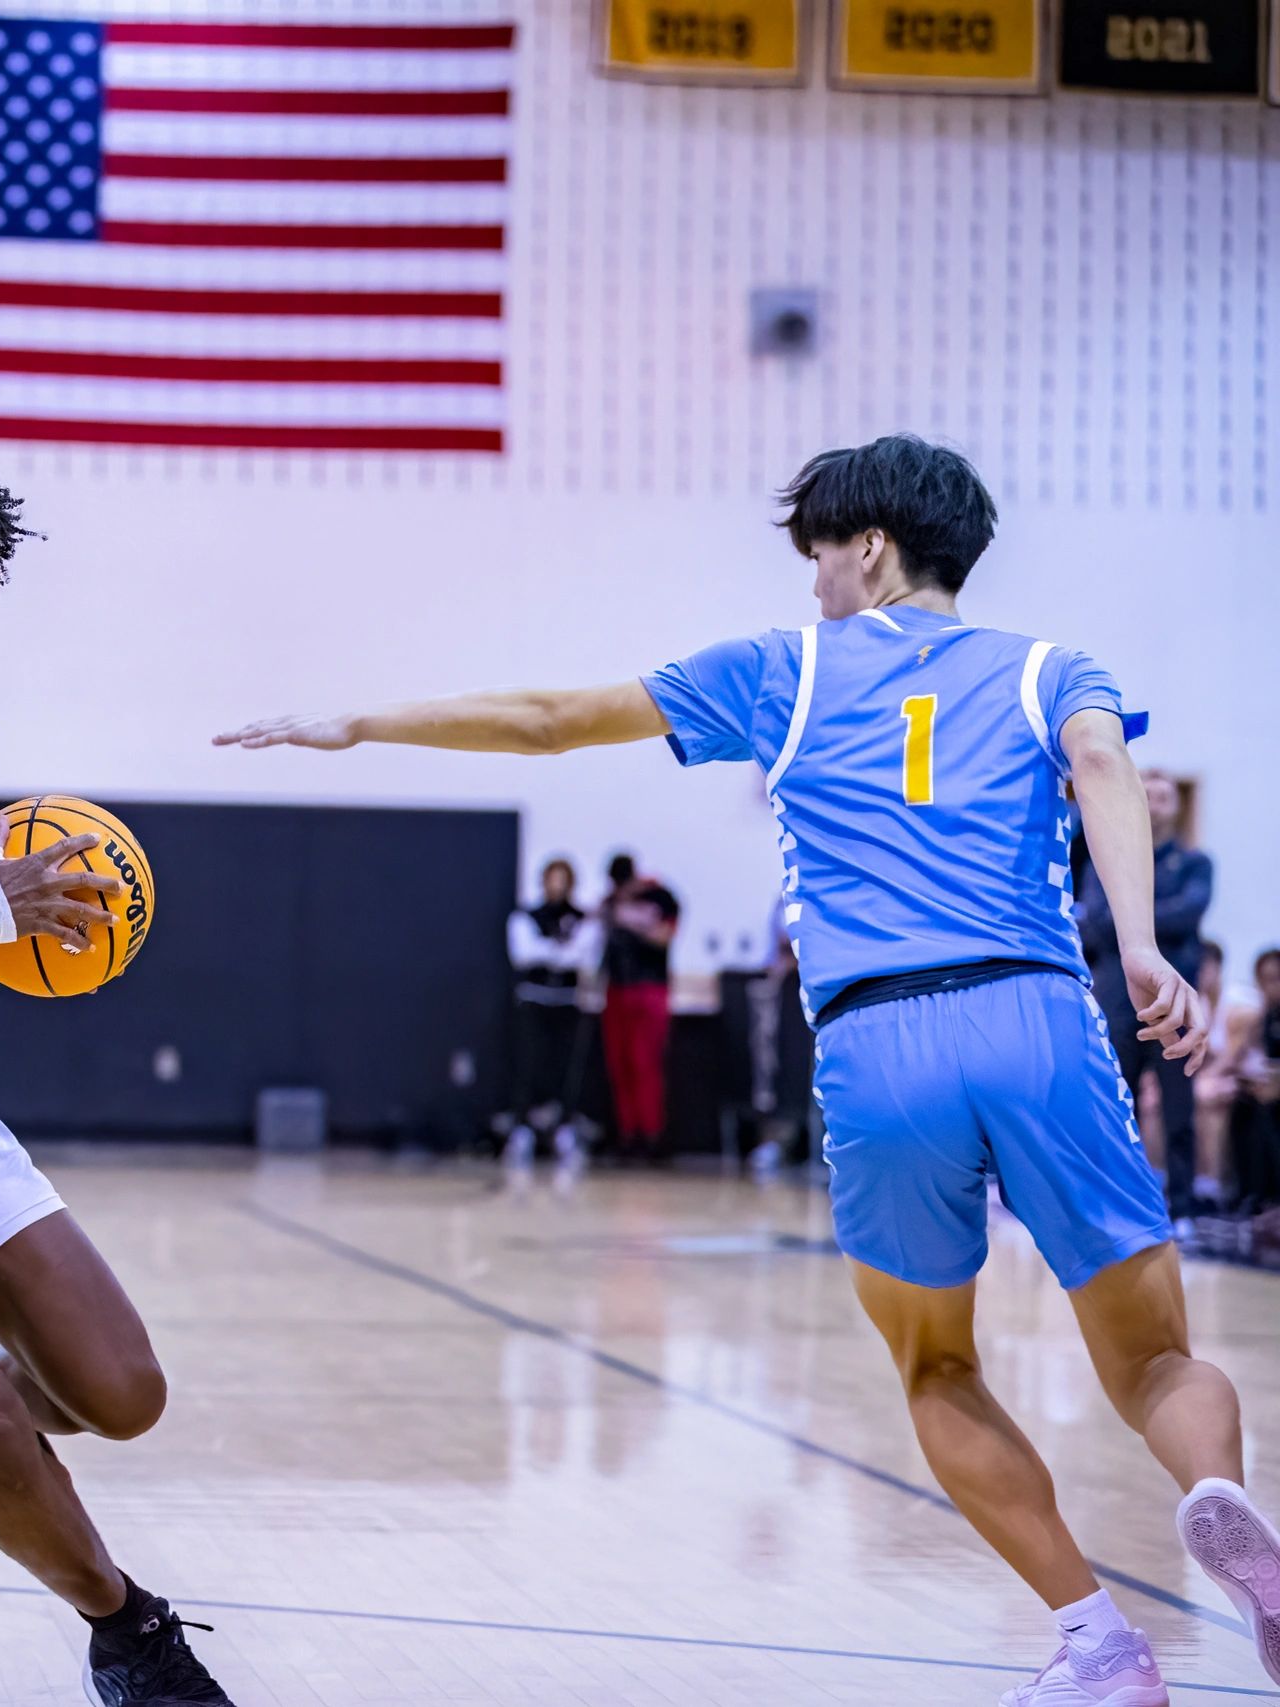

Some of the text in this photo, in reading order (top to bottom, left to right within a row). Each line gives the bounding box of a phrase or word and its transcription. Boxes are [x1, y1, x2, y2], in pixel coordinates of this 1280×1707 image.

[884, 8, 996, 53] 2020
[1106, 14, 1212, 63] 2021
[900, 694, 938, 806] 1
